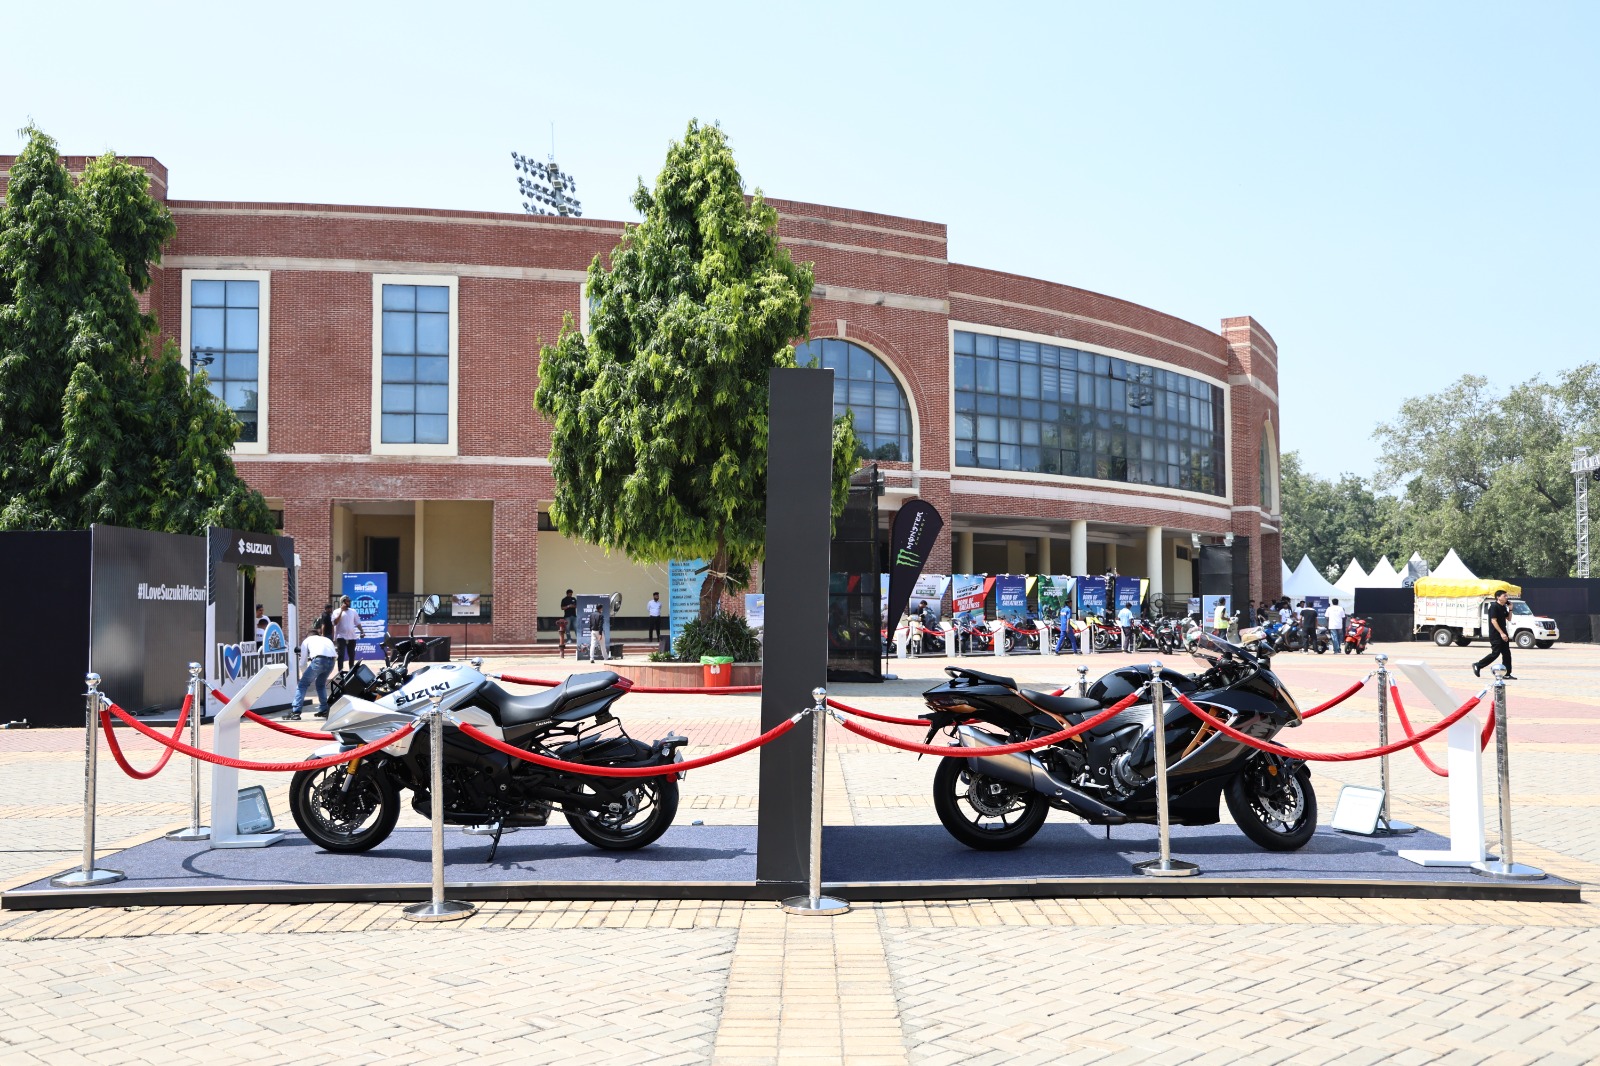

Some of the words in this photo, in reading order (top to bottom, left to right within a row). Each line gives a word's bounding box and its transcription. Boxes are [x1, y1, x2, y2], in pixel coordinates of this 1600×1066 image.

[906, 511, 924, 549] MONSTER
[245, 543, 272, 555] SUZUKI
[138, 583, 206, 601] #ILoveSuzukiMatsuri
[351, 600, 380, 609] LUCKY
[241, 643, 256, 653] SUZUKI
[395, 681, 450, 706] SUZUKI
